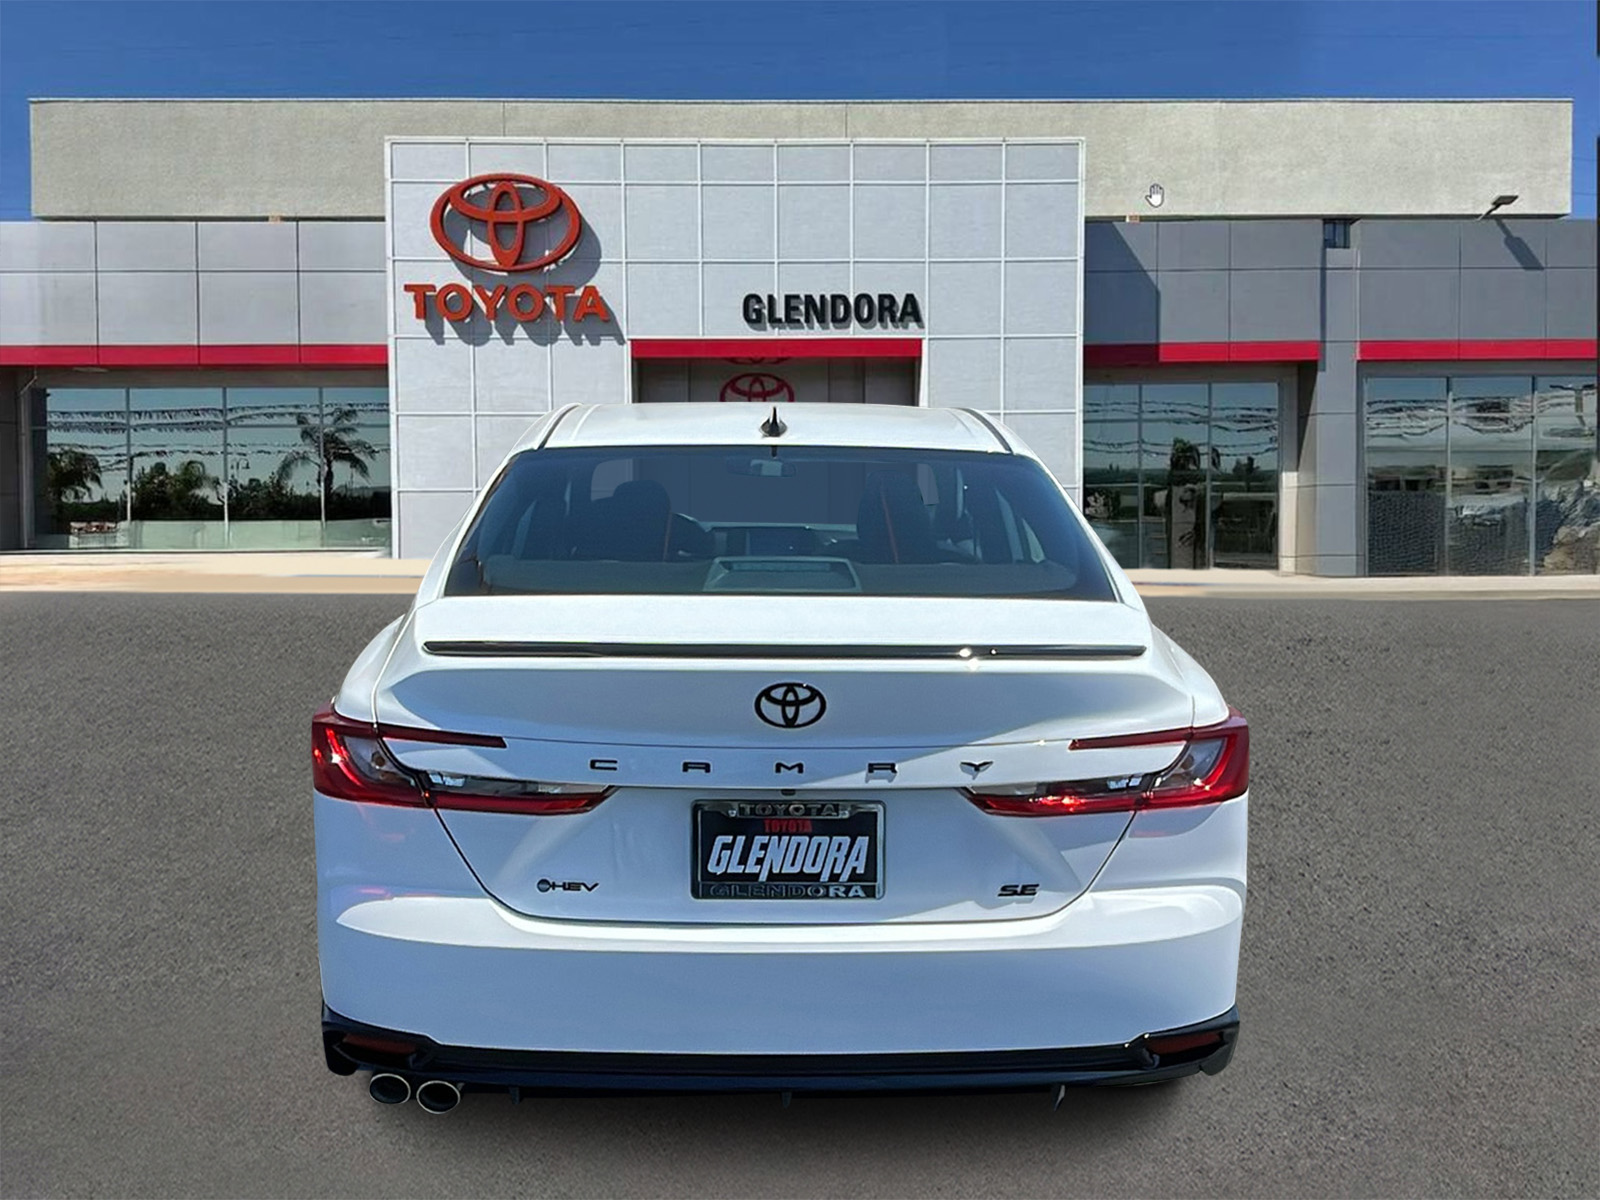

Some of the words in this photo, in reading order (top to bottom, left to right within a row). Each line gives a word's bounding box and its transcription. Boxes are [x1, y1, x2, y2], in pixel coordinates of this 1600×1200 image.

[403, 283, 611, 323] TOYOTA
[742, 293, 923, 325] GLENDORA
[589, 759, 994, 774] CAMRY
[738, 803, 837, 817] TOYOTA
[763, 819, 813, 833] TOYOTA
[707, 835, 870, 882] GLENDORA
[709, 885, 867, 898] GLENDORA
[997, 883, 1040, 897] SE
